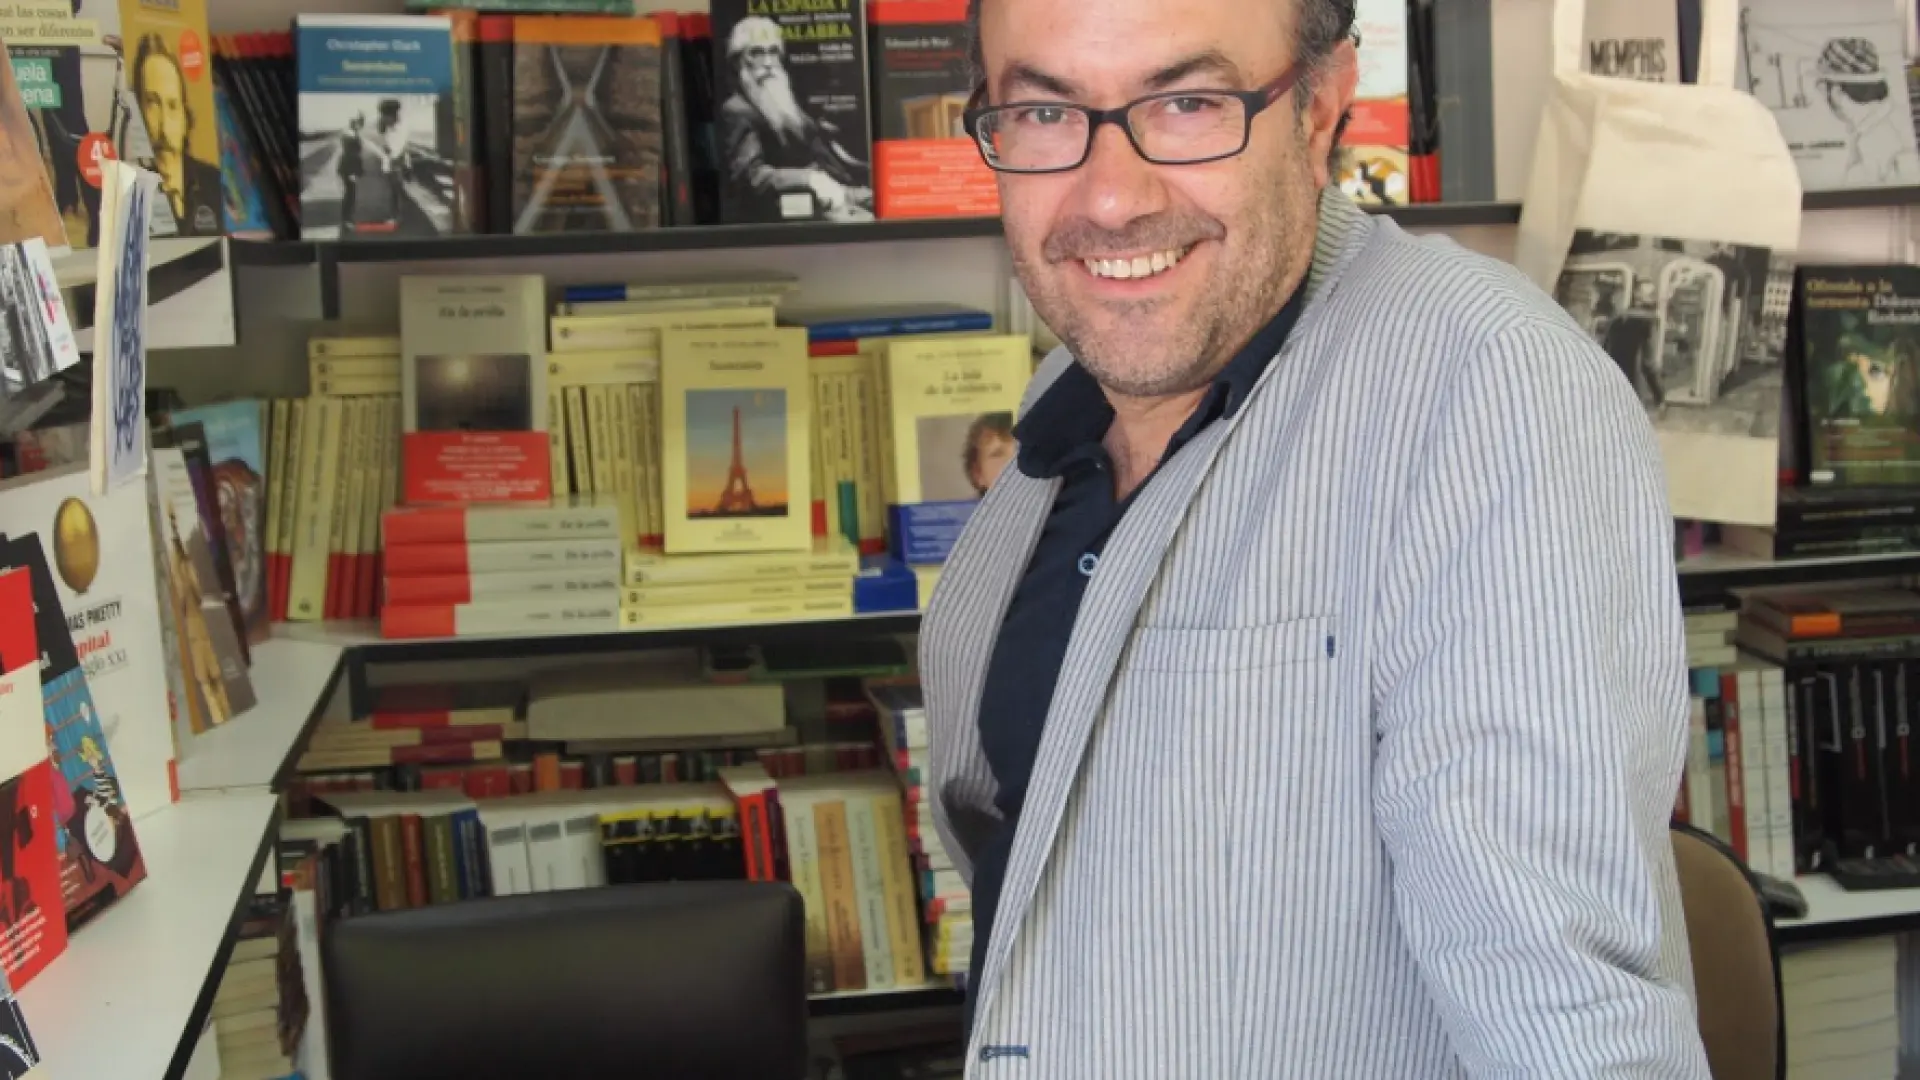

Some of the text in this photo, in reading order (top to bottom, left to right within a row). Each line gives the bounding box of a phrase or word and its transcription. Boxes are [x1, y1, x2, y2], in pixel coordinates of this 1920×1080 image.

[16, 5, 34, 18] las
[36, 8, 67, 19] cosas
[17, 27, 35, 38] ser
[38, 21, 94, 38] diferentes
[391, 38, 421, 52] Clark
[1590, 38, 1666, 77] MEMPHIS
[1805, 277, 1863, 292] Ofrenda
[1879, 277, 1893, 292] la
[1874, 292, 1920, 308] Dolore
[1866, 307, 1920, 323] Redond
[87, 601, 121, 624] PIKETTY
